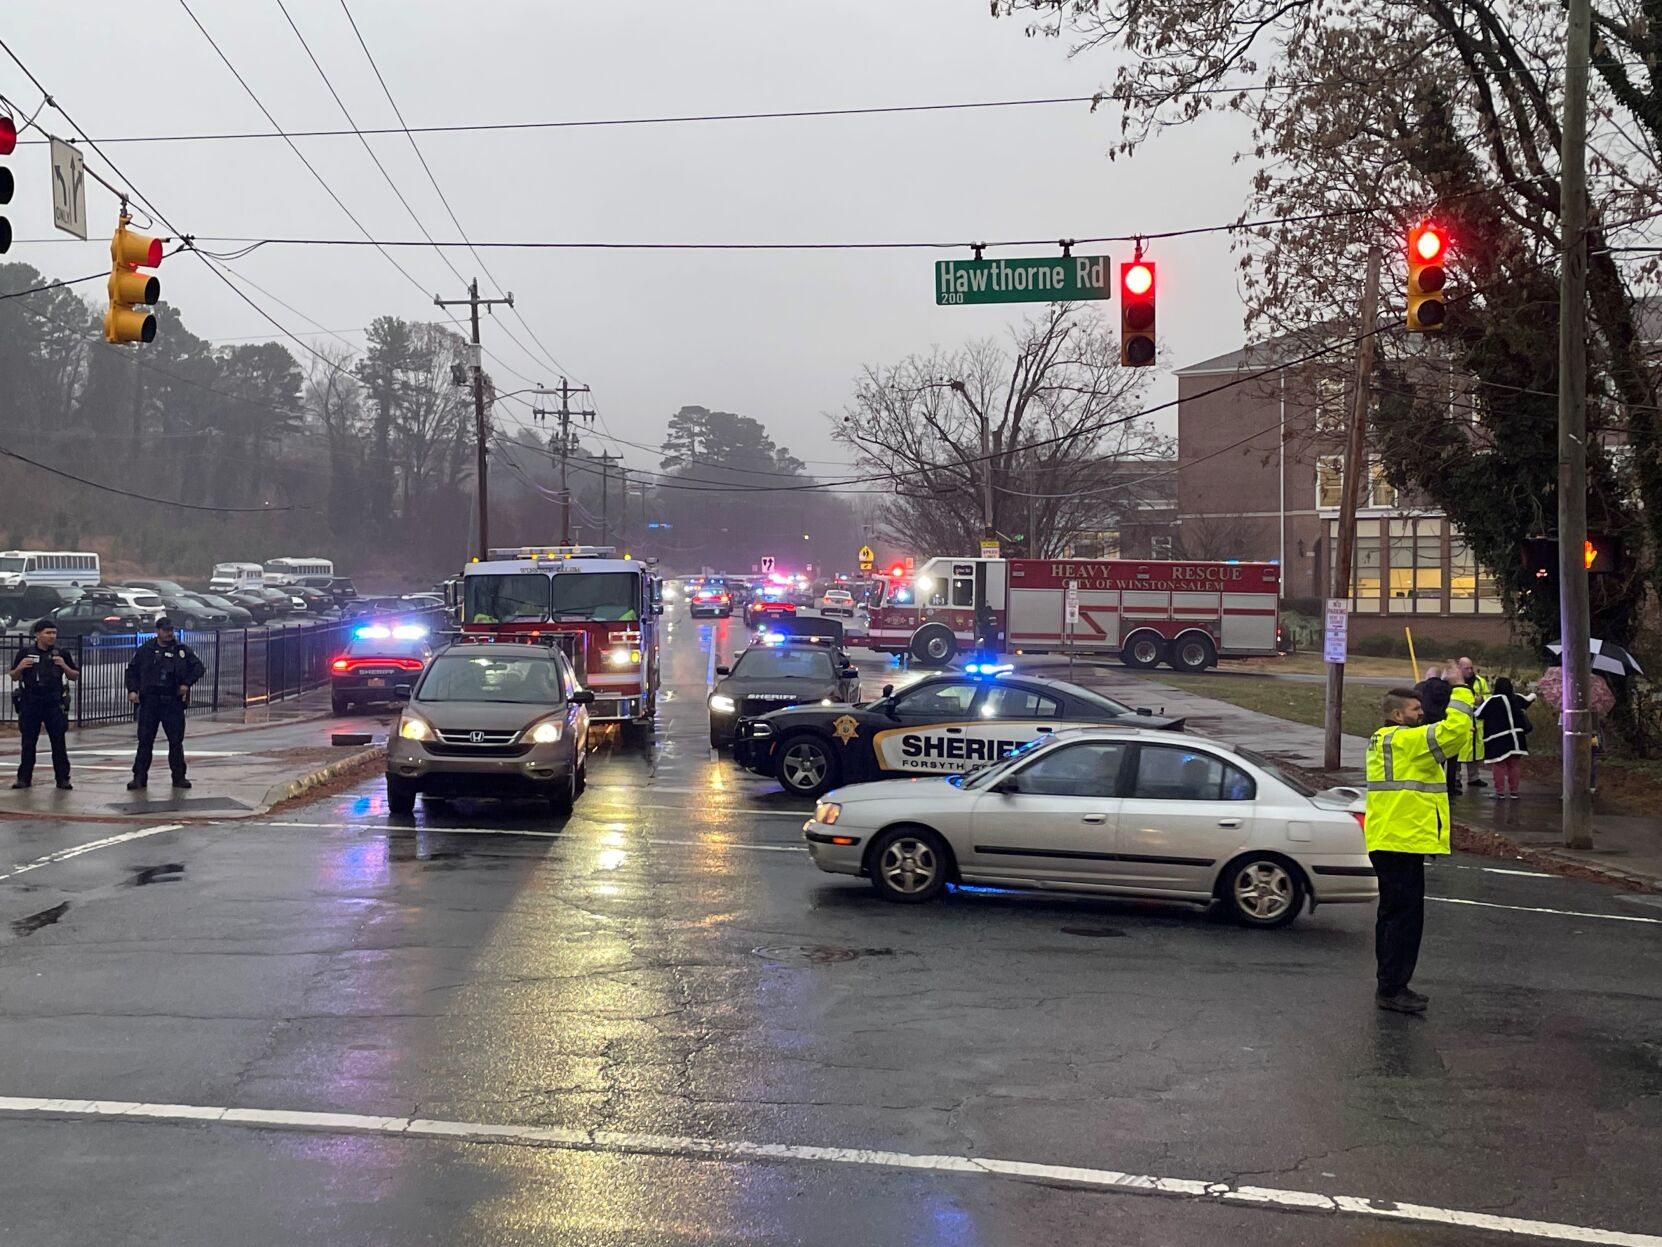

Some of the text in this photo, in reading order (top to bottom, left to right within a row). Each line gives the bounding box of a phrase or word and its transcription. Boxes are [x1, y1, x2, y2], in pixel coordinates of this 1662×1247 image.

[56, 206, 71, 224] ONLY
[940, 257, 1104, 293] Hawthorne Rd
[941, 292, 964, 304] 200
[1051, 564, 1243, 580] HEAVY RESCUE
[1062, 578, 1225, 591] CTY OF WINSTON-SALEM
[902, 759, 964, 771] FORSYTH
